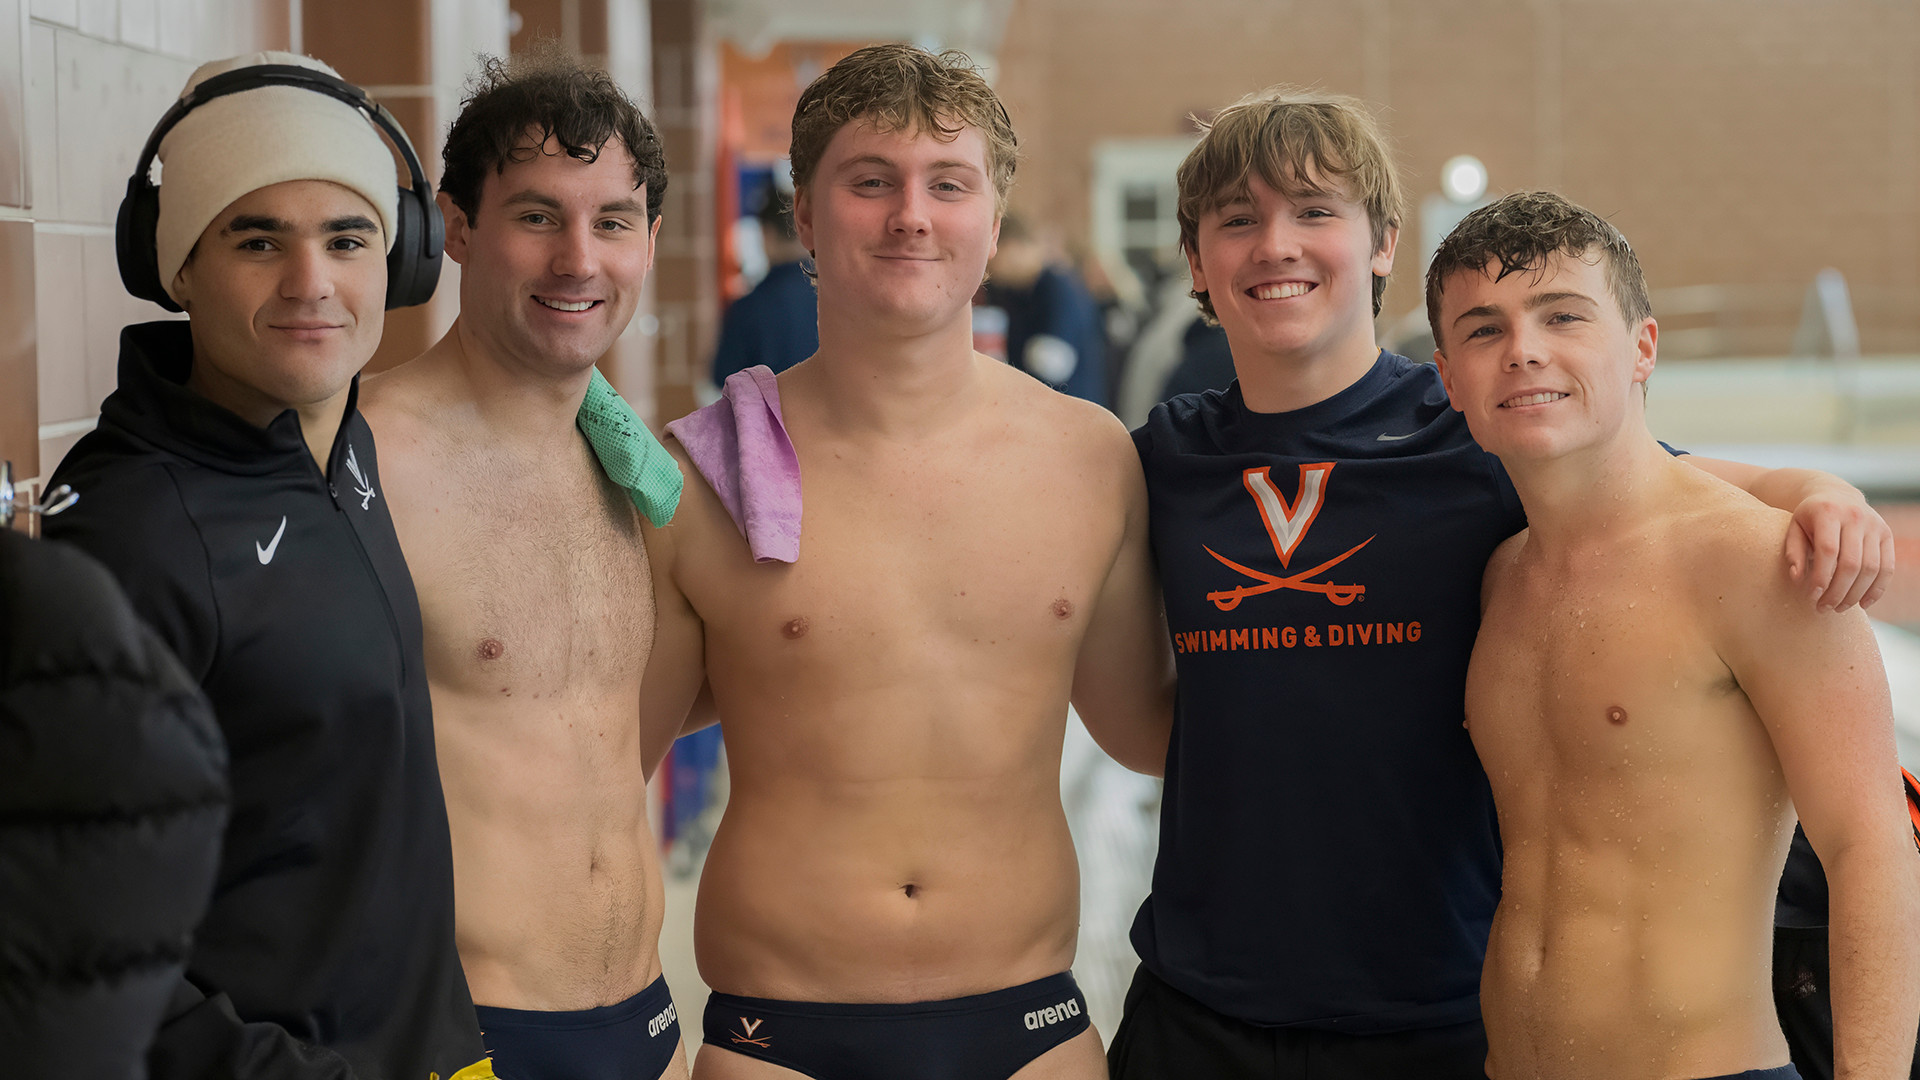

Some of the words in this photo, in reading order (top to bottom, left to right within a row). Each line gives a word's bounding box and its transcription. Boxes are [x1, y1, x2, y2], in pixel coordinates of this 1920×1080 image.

[1243, 461, 1338, 570] V
[1175, 626, 1298, 654] SWIMMING
[1304, 625, 1323, 648] &
[1328, 621, 1423, 647] DIVING
[648, 1002, 677, 1038] arena
[739, 1016, 764, 1039] V
[1024, 998, 1081, 1031] arena
